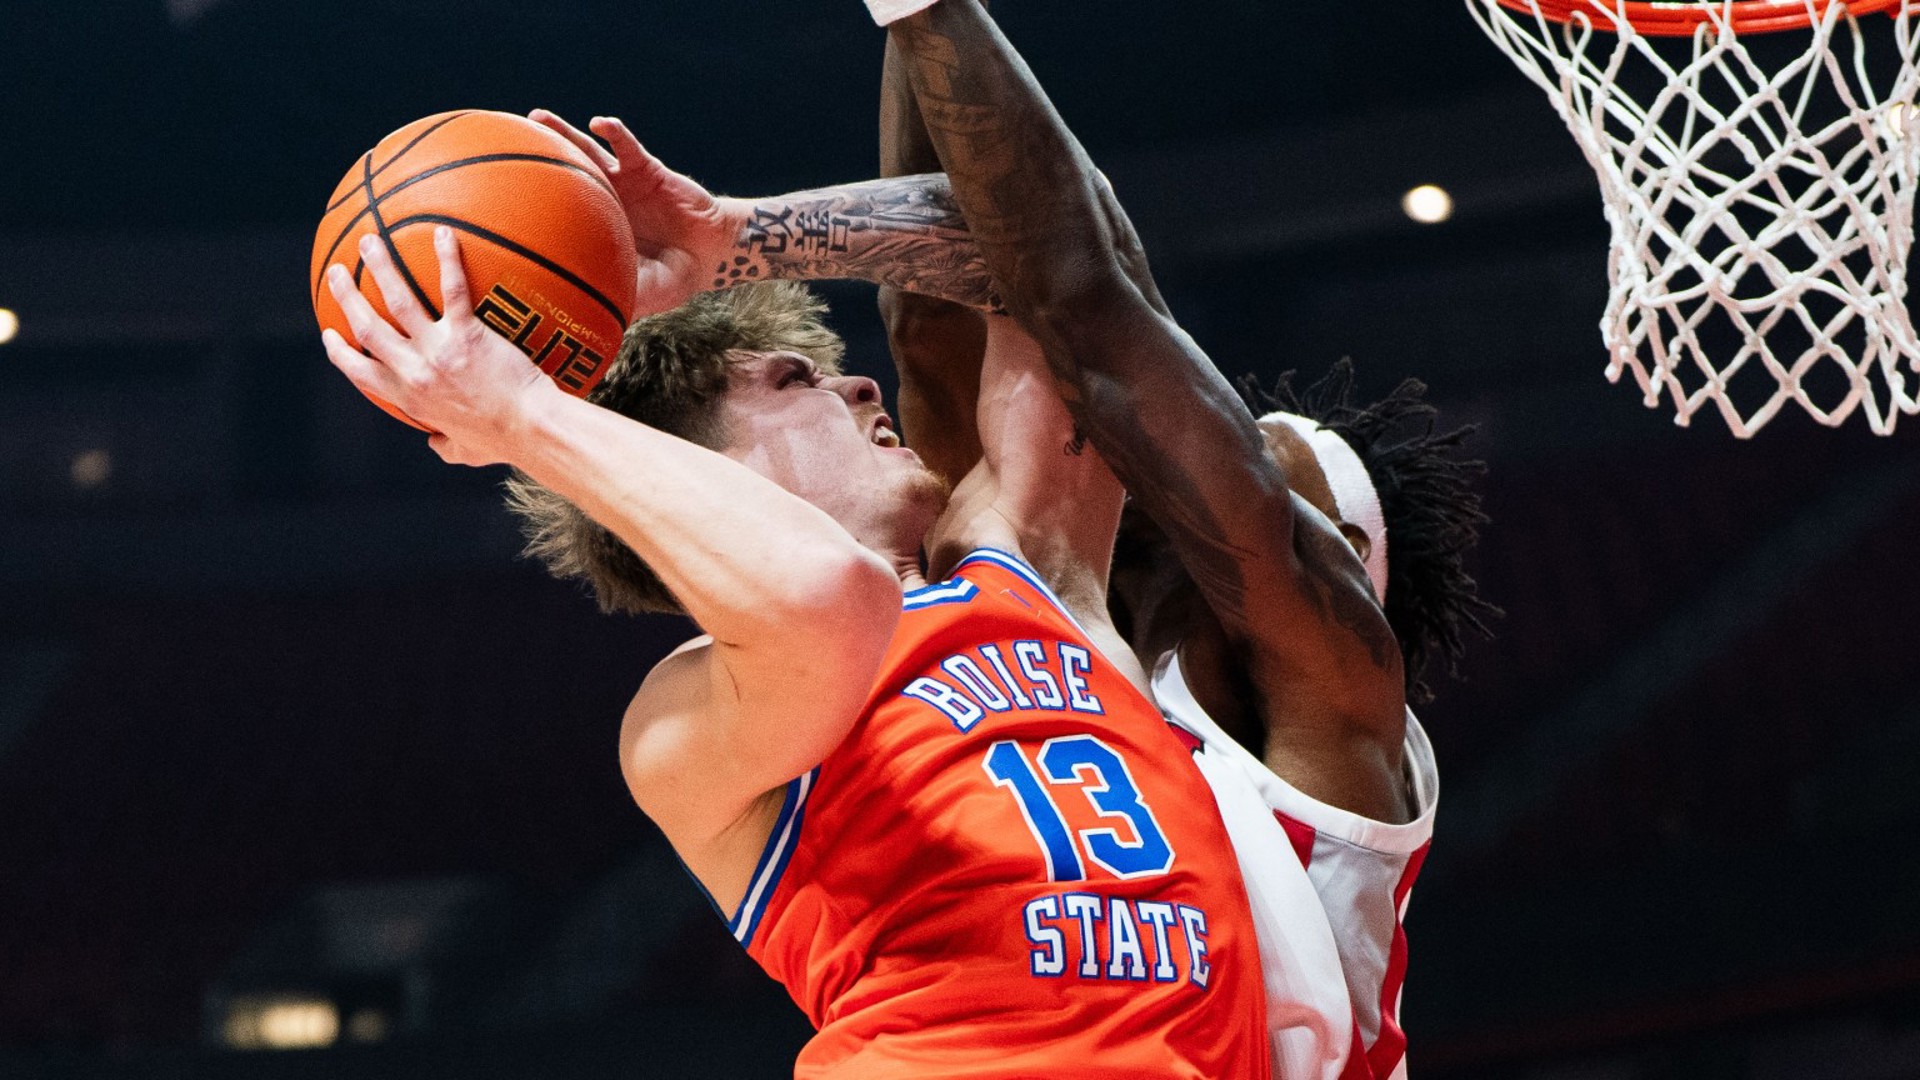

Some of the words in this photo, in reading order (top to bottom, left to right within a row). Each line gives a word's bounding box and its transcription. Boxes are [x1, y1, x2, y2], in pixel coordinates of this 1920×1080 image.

[747, 205, 851, 257] 改善
[902, 640, 1105, 734] BOISE
[981, 733, 1176, 883] 13
[1022, 891, 1212, 991] STATE
